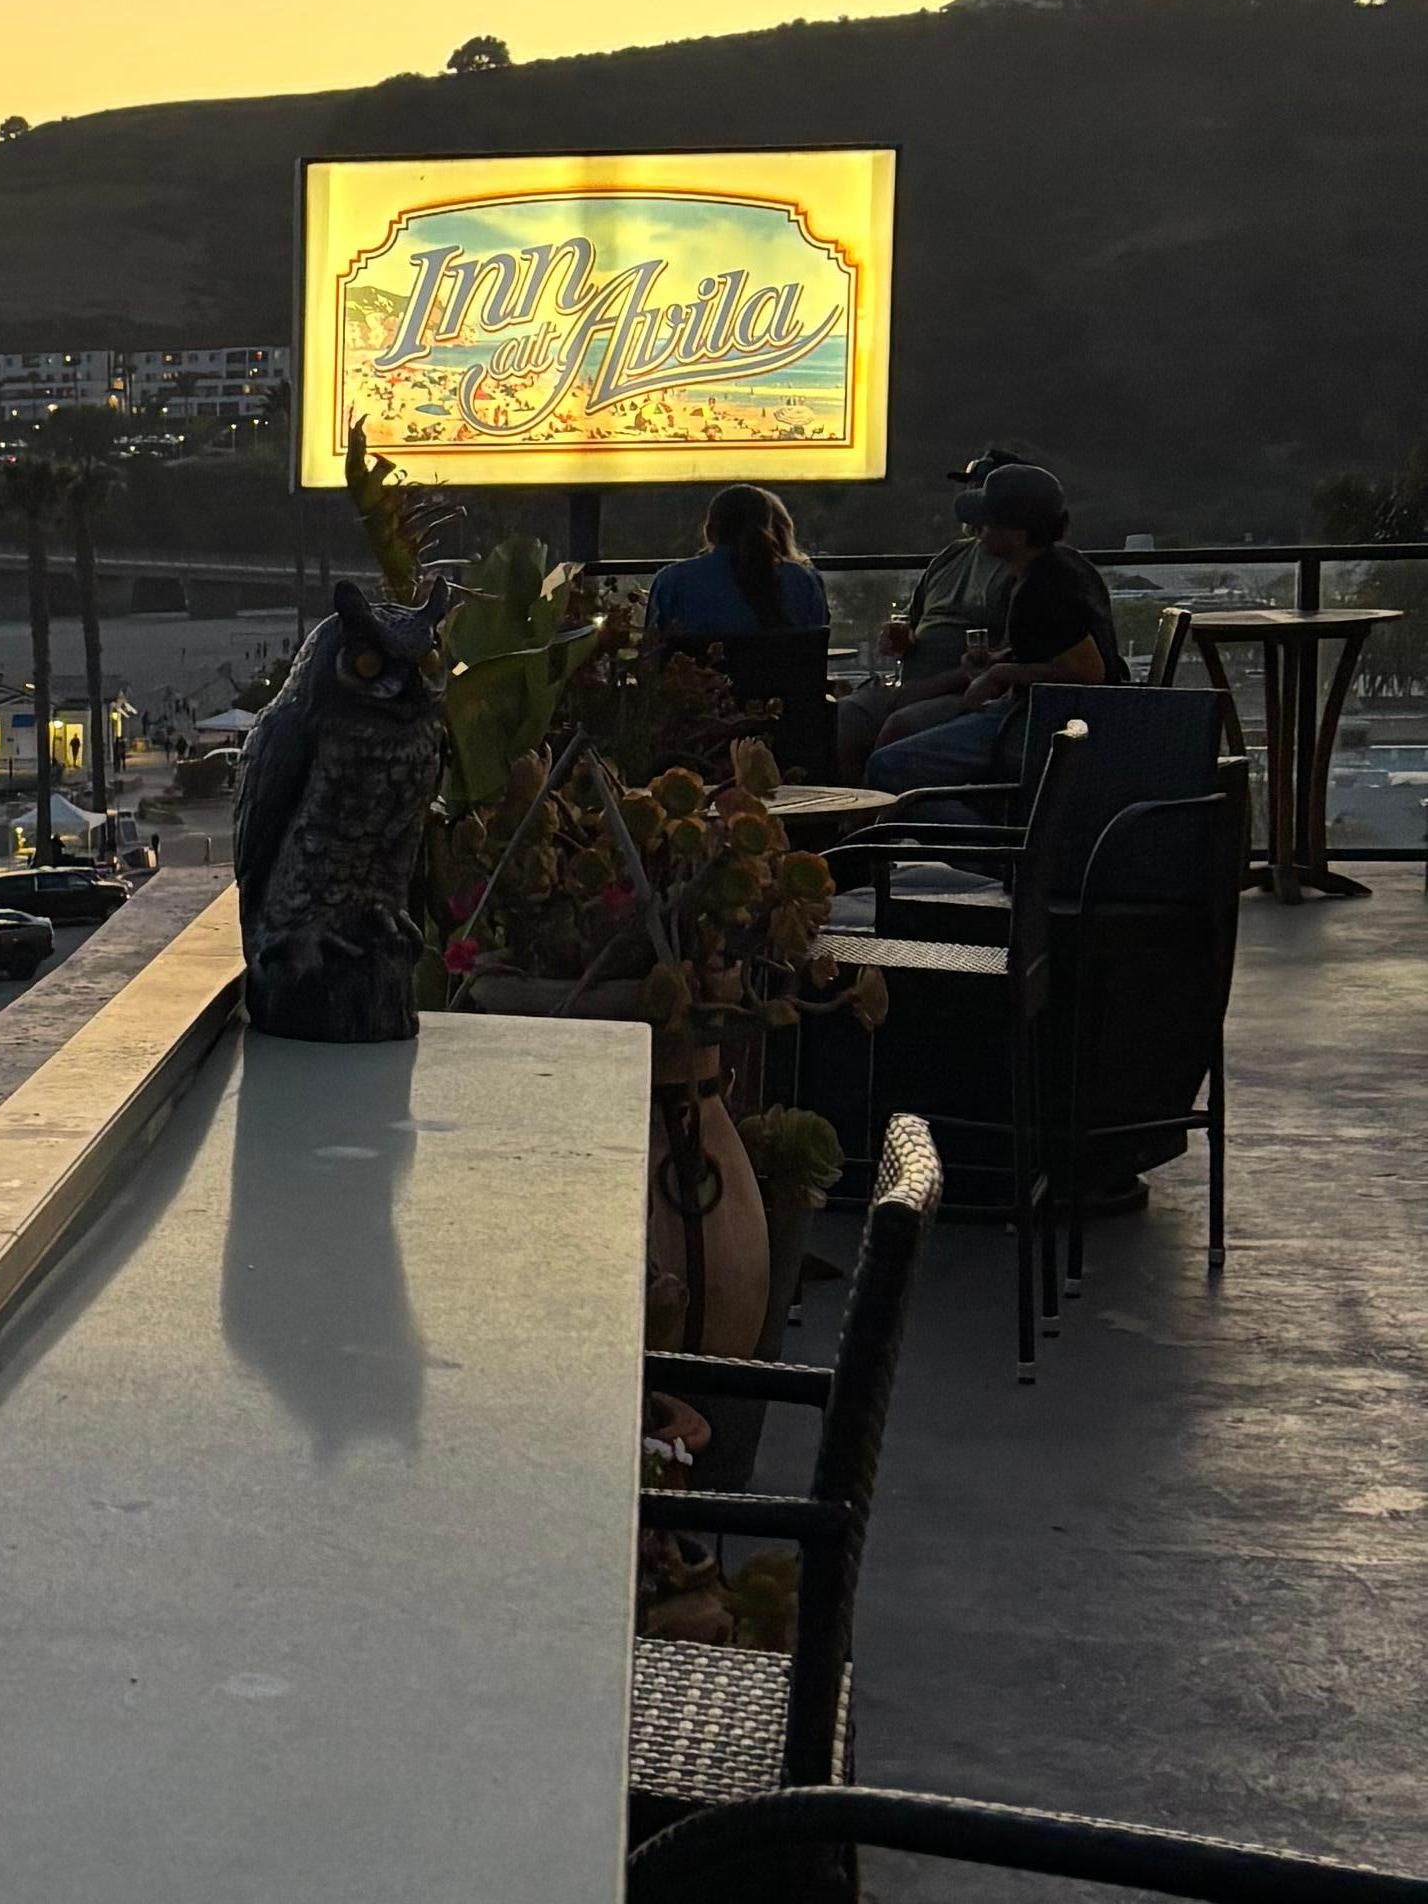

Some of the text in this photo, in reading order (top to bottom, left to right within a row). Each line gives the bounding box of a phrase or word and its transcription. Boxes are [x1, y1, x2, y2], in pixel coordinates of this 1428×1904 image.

[376, 236, 842, 437] Inn at Avila
